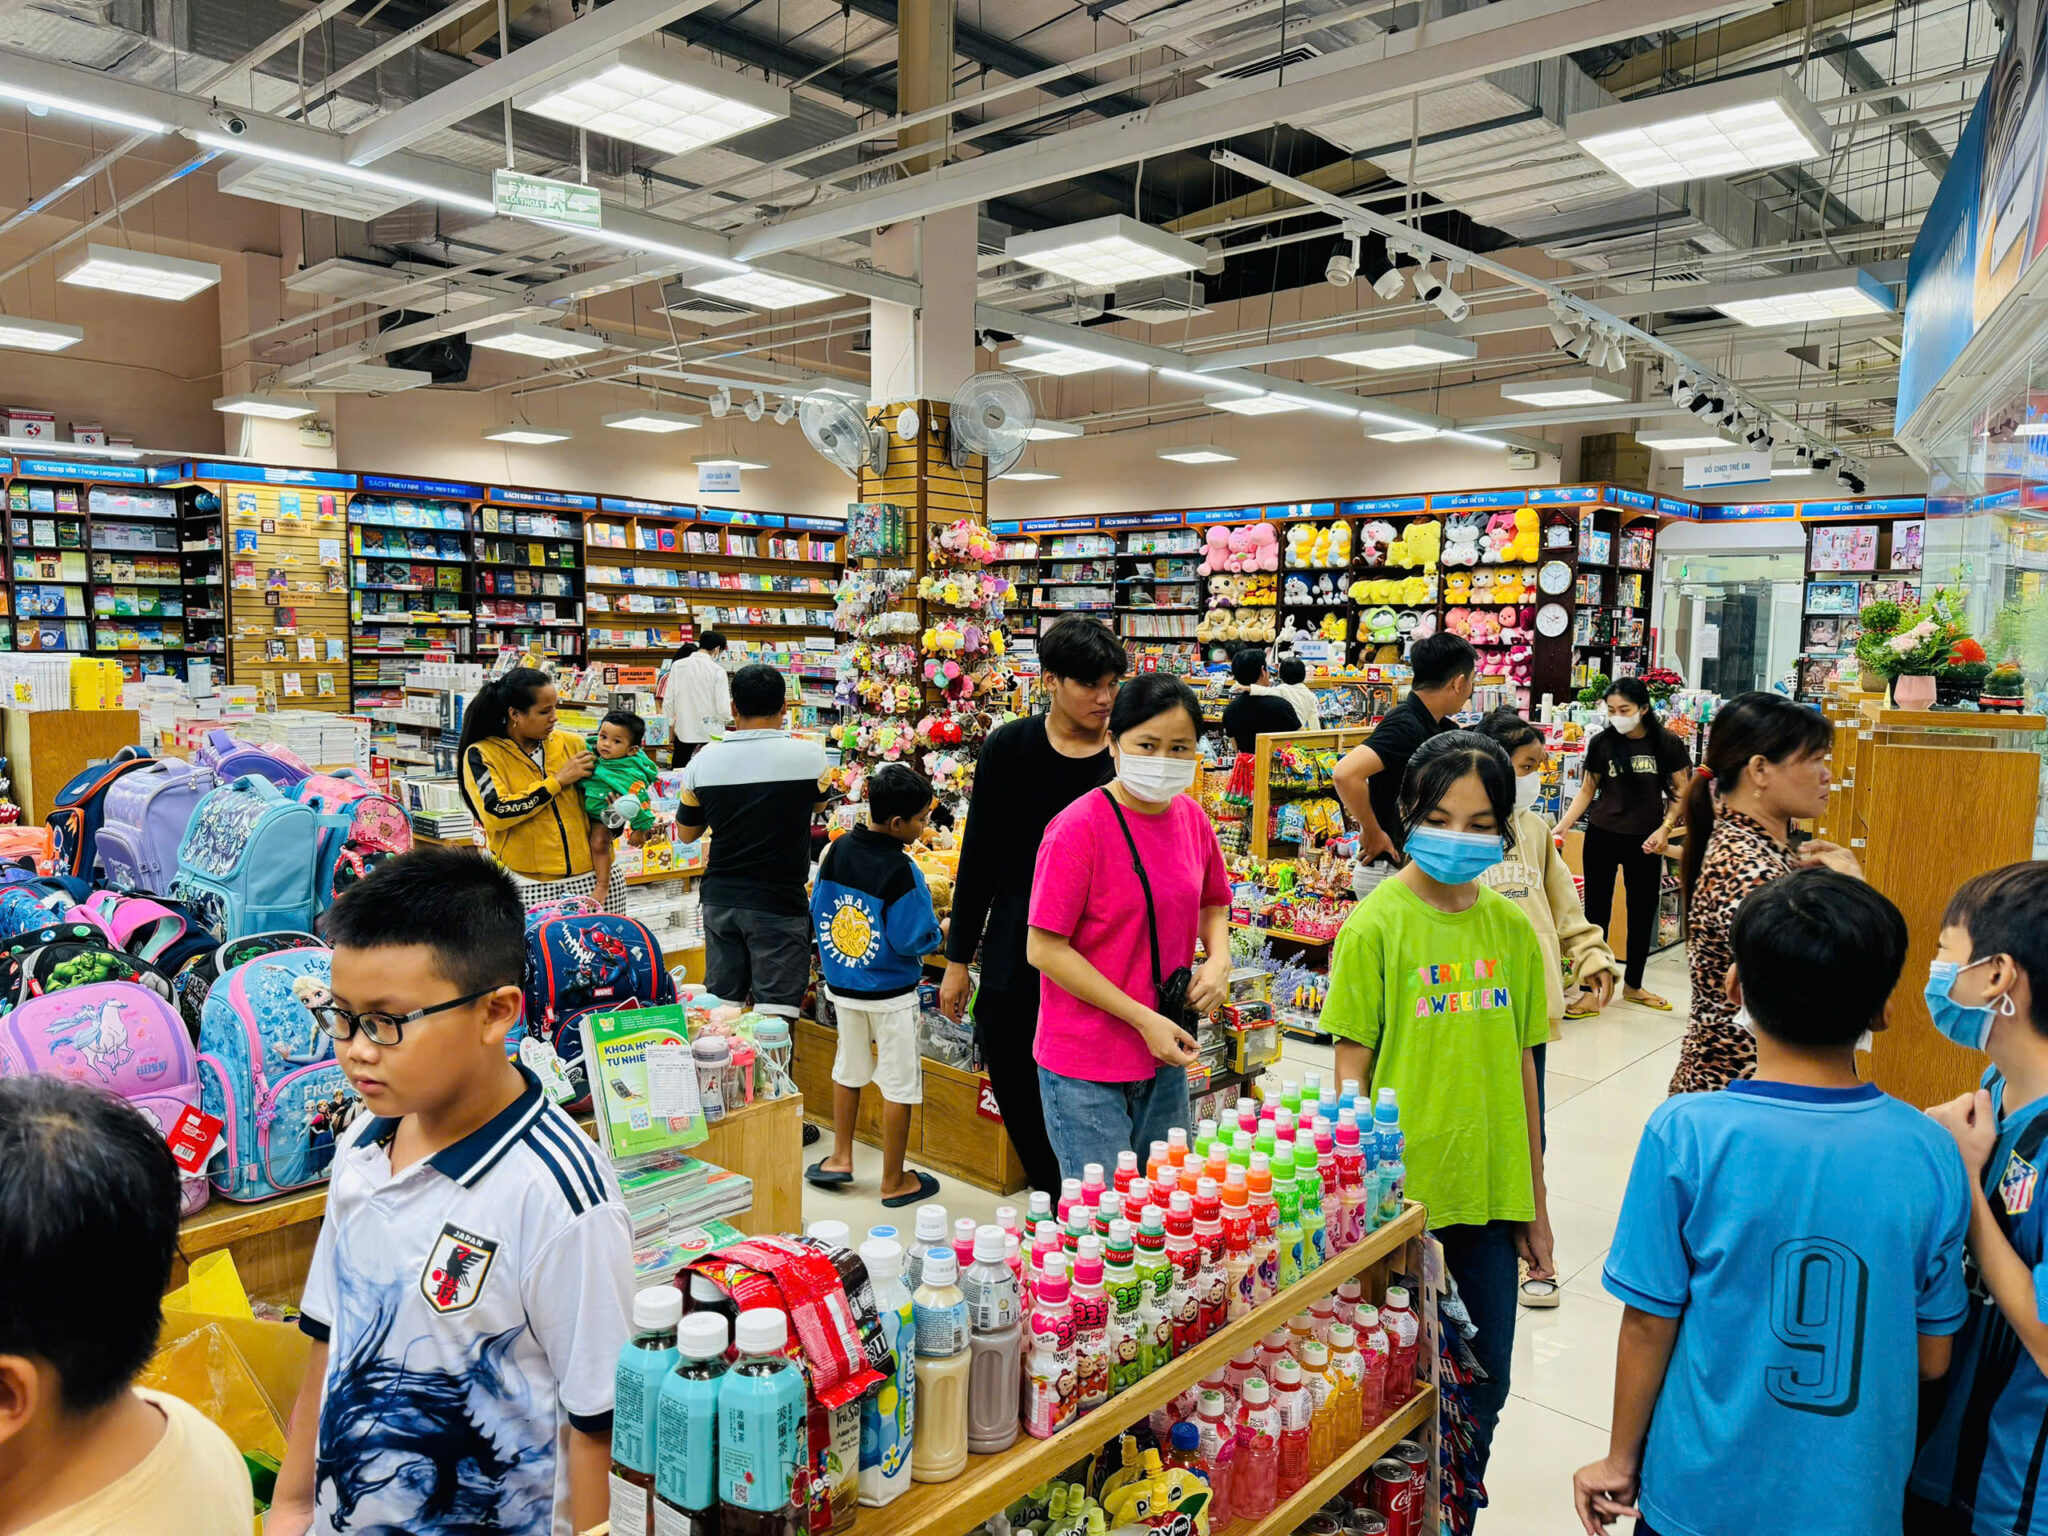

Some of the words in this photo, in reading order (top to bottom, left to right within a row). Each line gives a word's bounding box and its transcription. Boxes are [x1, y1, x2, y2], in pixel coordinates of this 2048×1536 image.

[508, 181, 541, 196] EXIT
[1742, 462, 1751, 470] EM
[1368, 671, 1379, 681] 35
[374, 767, 387, 777] BEST
[604, 1043, 635, 1055] KHOA
[621, 1051, 646, 1066] NHIÊ
[136, 1060, 167, 1076] ELEMENT
[303, 1078, 351, 1101] FROZE
[453, 1230, 484, 1247] JAPAN
[1182, 1254, 1201, 1280] 코코
[1153, 1269, 1173, 1298] 코코
[431, 1284, 460, 1303] JFA
[1115, 1287, 1141, 1311] 코코
[1113, 1315, 1130, 1326] Yogur
[1765, 1236, 1869, 1417] 9
[1056, 1320, 1078, 1348] 코코
[1052, 1351, 1070, 1364] Yogur
[1174, 1520, 1188, 1535] MORE
